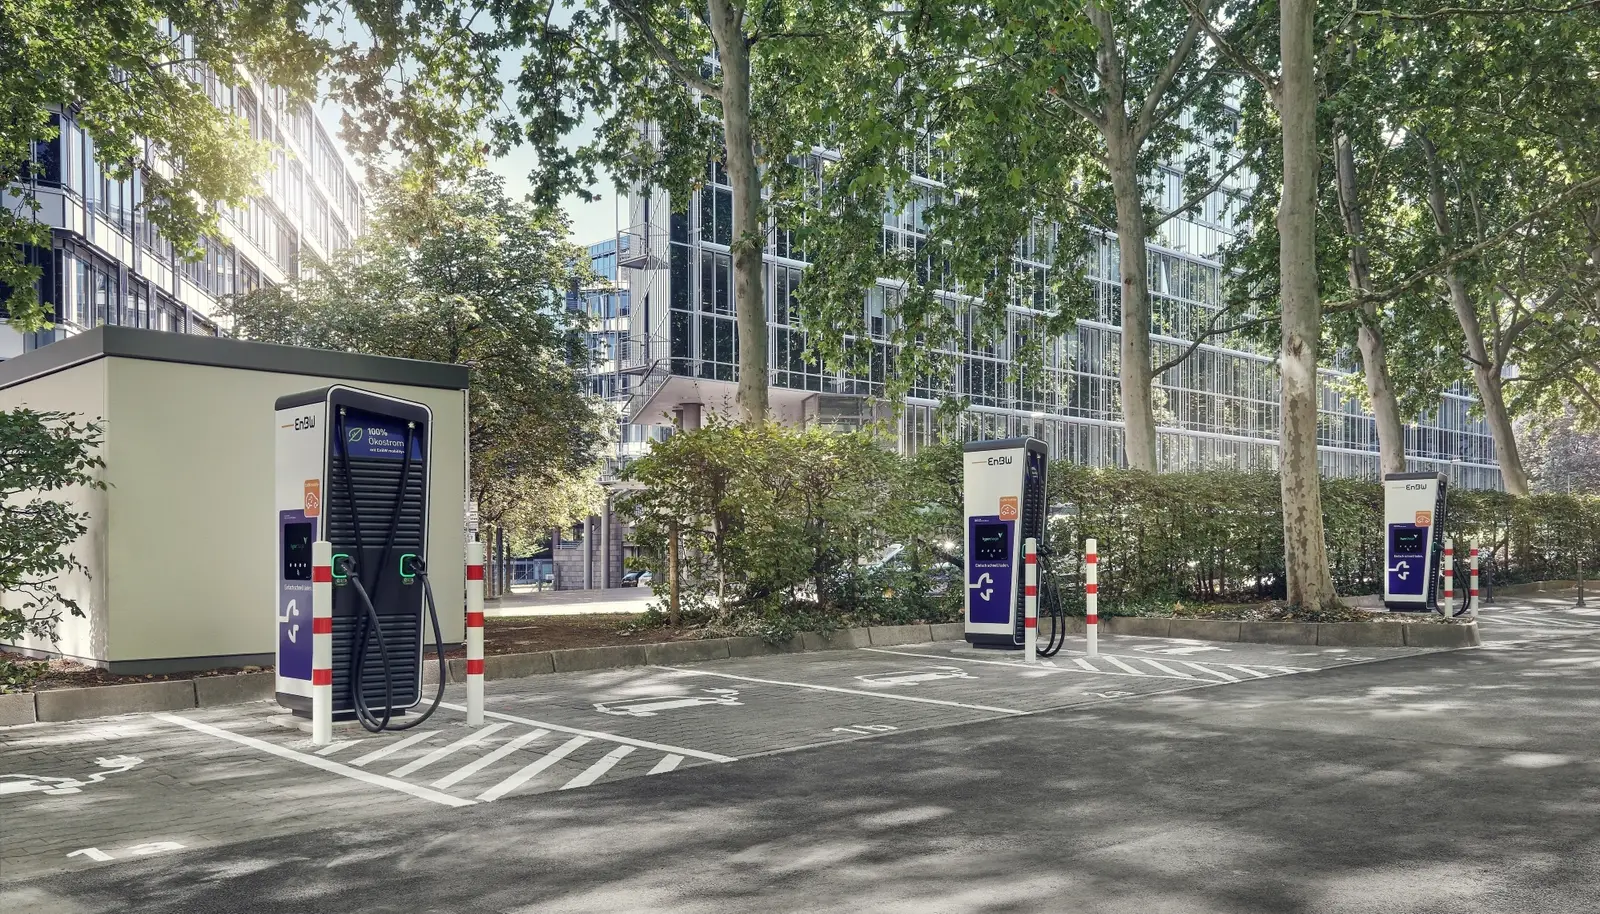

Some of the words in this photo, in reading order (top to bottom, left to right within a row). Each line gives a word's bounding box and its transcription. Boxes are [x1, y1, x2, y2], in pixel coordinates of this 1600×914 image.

[294, 415, 316, 431] EnBW
[367, 427, 388, 436] 100%
[368, 436, 405, 447] Ökostrom
[987, 456, 1013, 466] EnBW
[1405, 483, 1427, 491] EnBW
